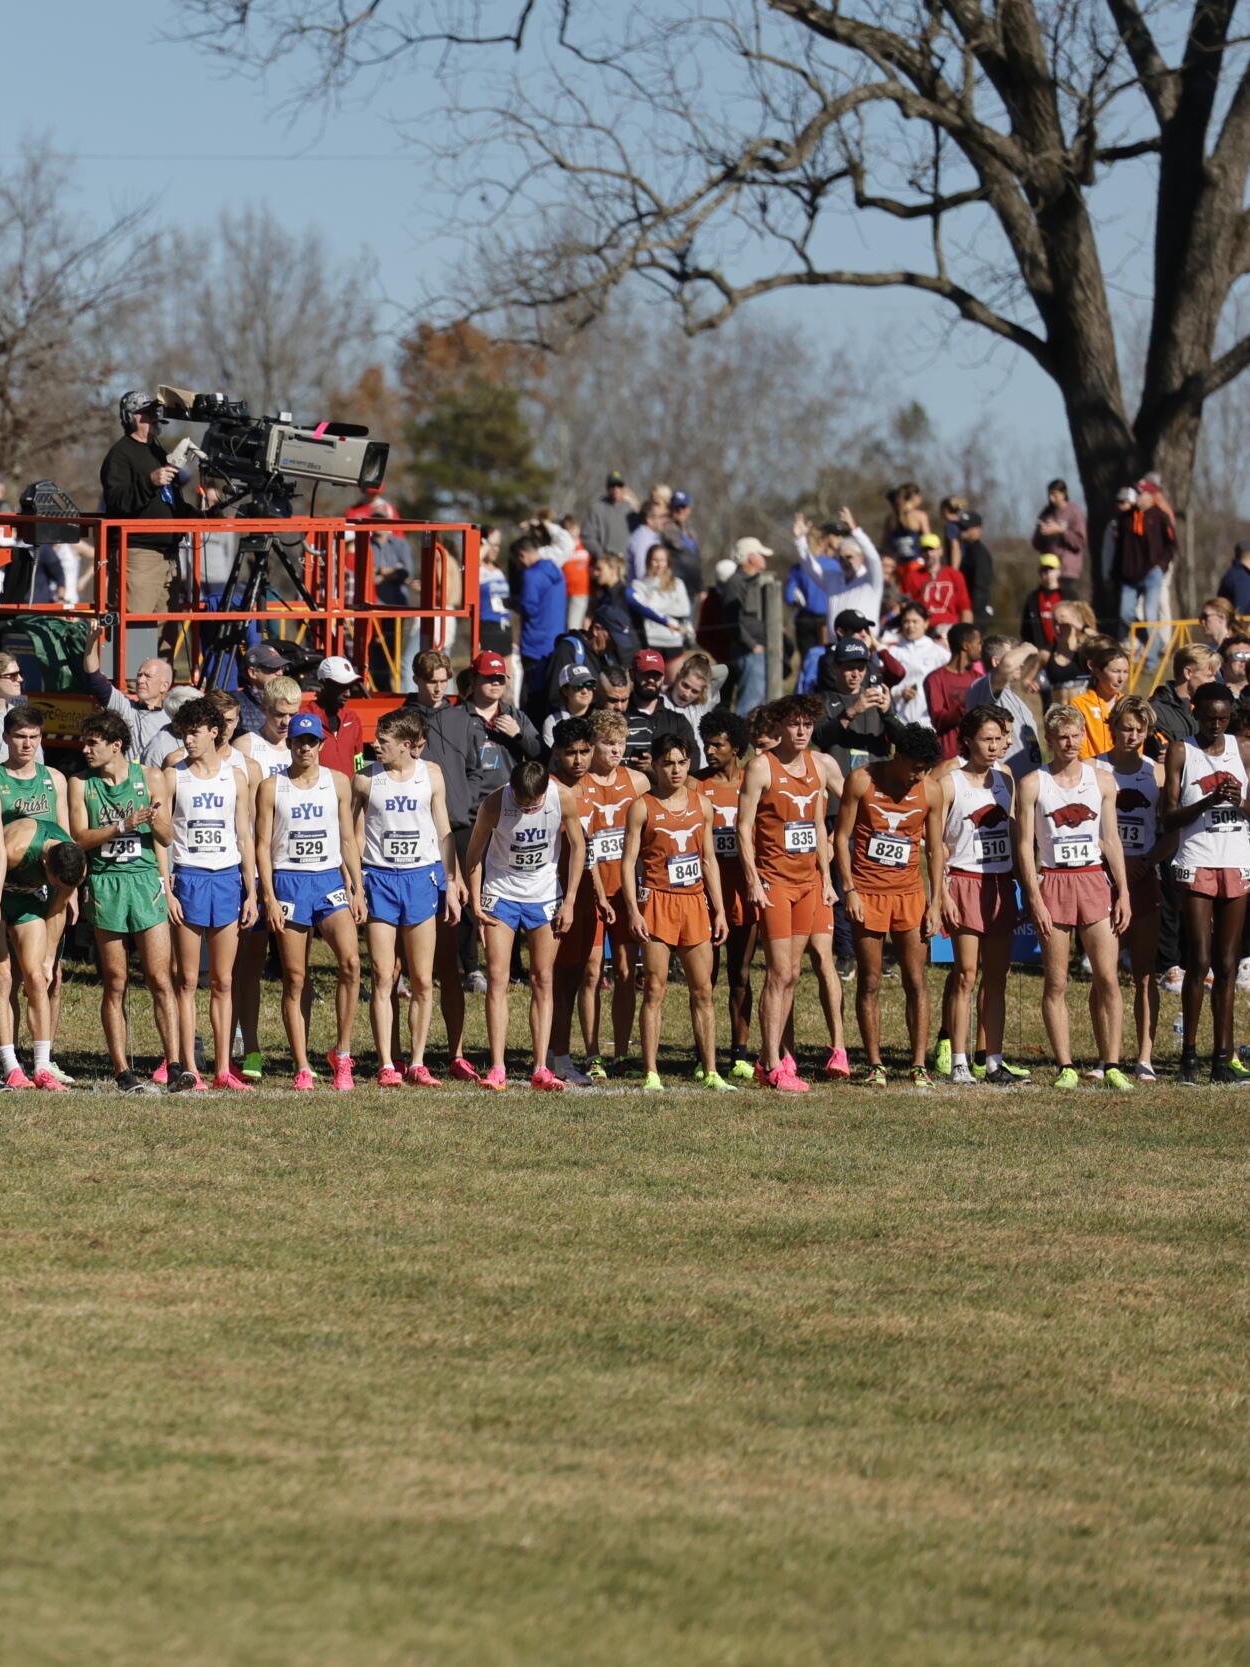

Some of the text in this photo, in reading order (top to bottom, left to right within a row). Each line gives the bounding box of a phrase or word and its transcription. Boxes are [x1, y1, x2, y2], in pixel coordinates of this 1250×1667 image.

[14, 795, 50, 816] Irish
[192, 792, 224, 809] BYU
[385, 795, 418, 813] BYU
[99, 799, 134, 820] Irish
[291, 803, 324, 820] BYU
[1211, 810, 1238, 824] 508
[194, 830, 222, 844] 536
[515, 828, 547, 842] BYU
[791, 831, 814, 846] 835
[107, 839, 136, 855] 738
[295, 840, 323, 856] 529
[390, 841, 418, 855] 537
[875, 842, 904, 860] 828
[982, 840, 1006, 856] 510
[1061, 844, 1089, 860] 514
[515, 852, 543, 865] 532
[675, 862, 699, 879] 840
